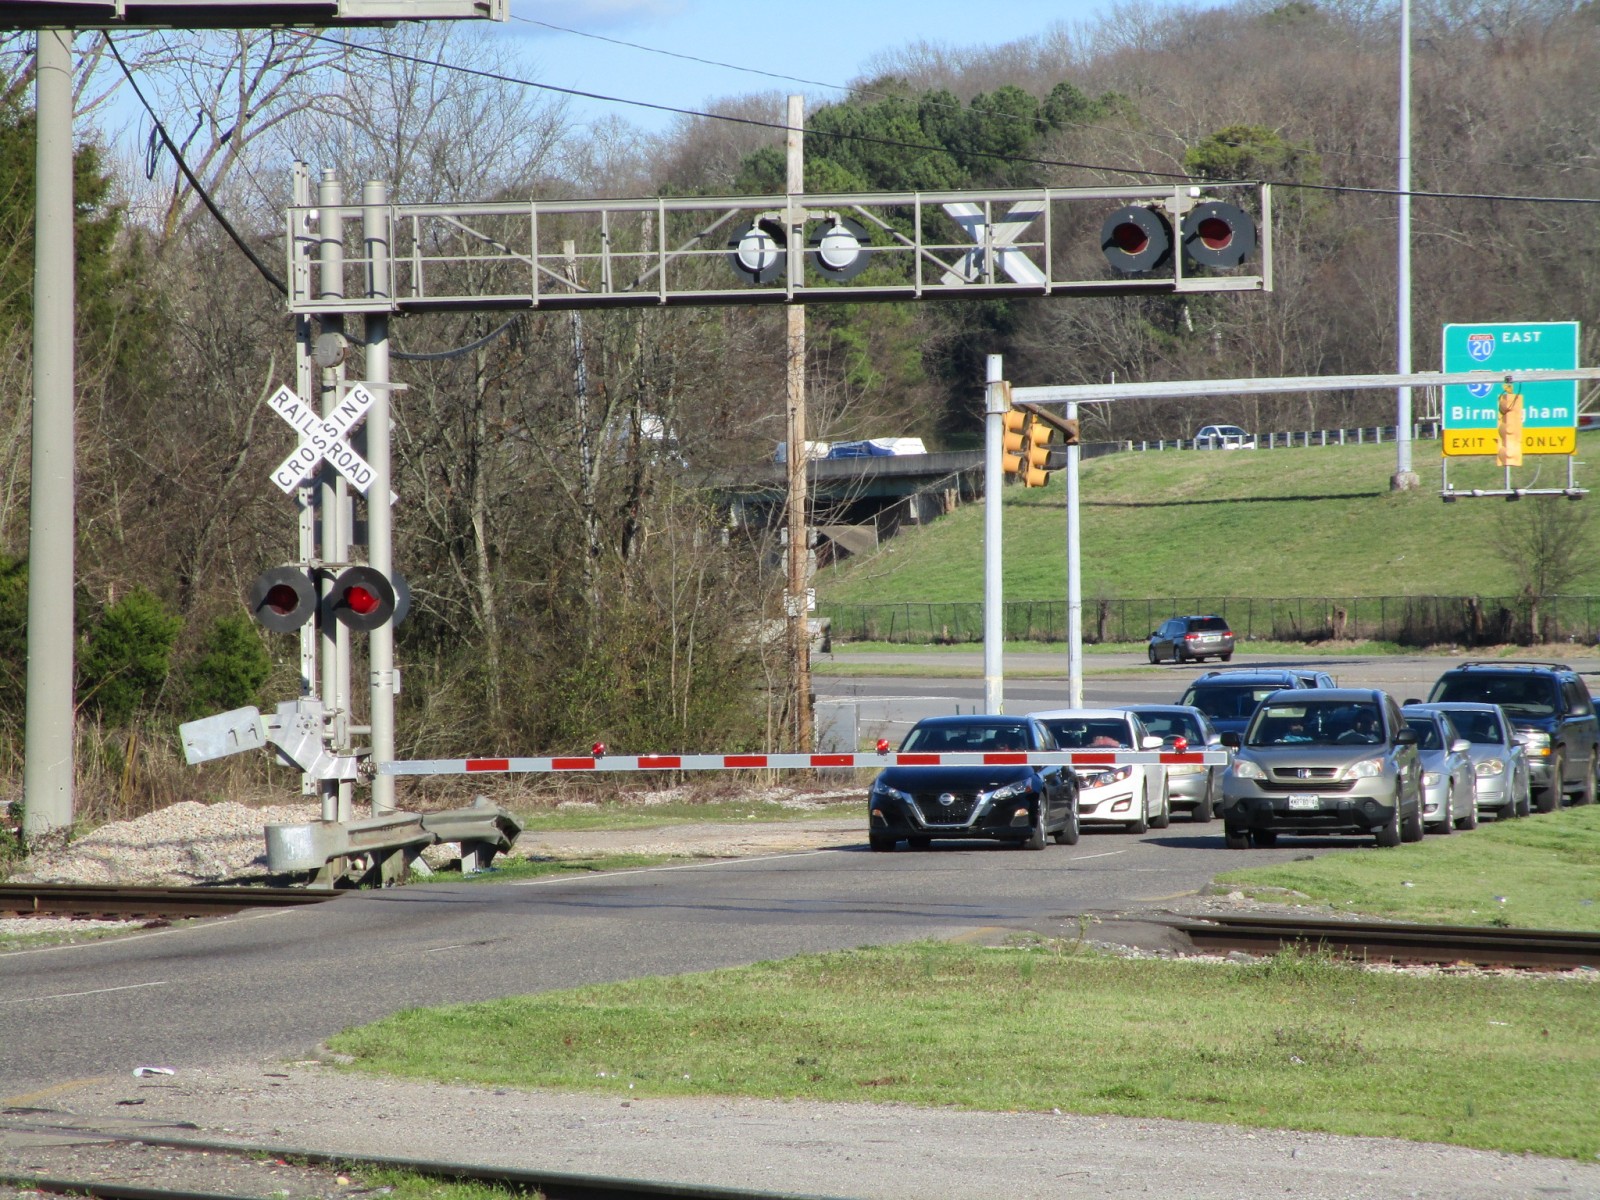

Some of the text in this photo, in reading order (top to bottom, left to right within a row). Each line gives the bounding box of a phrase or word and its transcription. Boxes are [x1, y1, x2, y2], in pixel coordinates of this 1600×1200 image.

[1502, 332, 1542, 343] EAST
[1473, 341, 1491, 356] 20
[1452, 406, 1568, 422] Birmham
[273, 390, 371, 485] RAIL ROAD
[277, 389, 369, 487] CROSSING
[1452, 436, 1567, 448] EXIT ONLY
